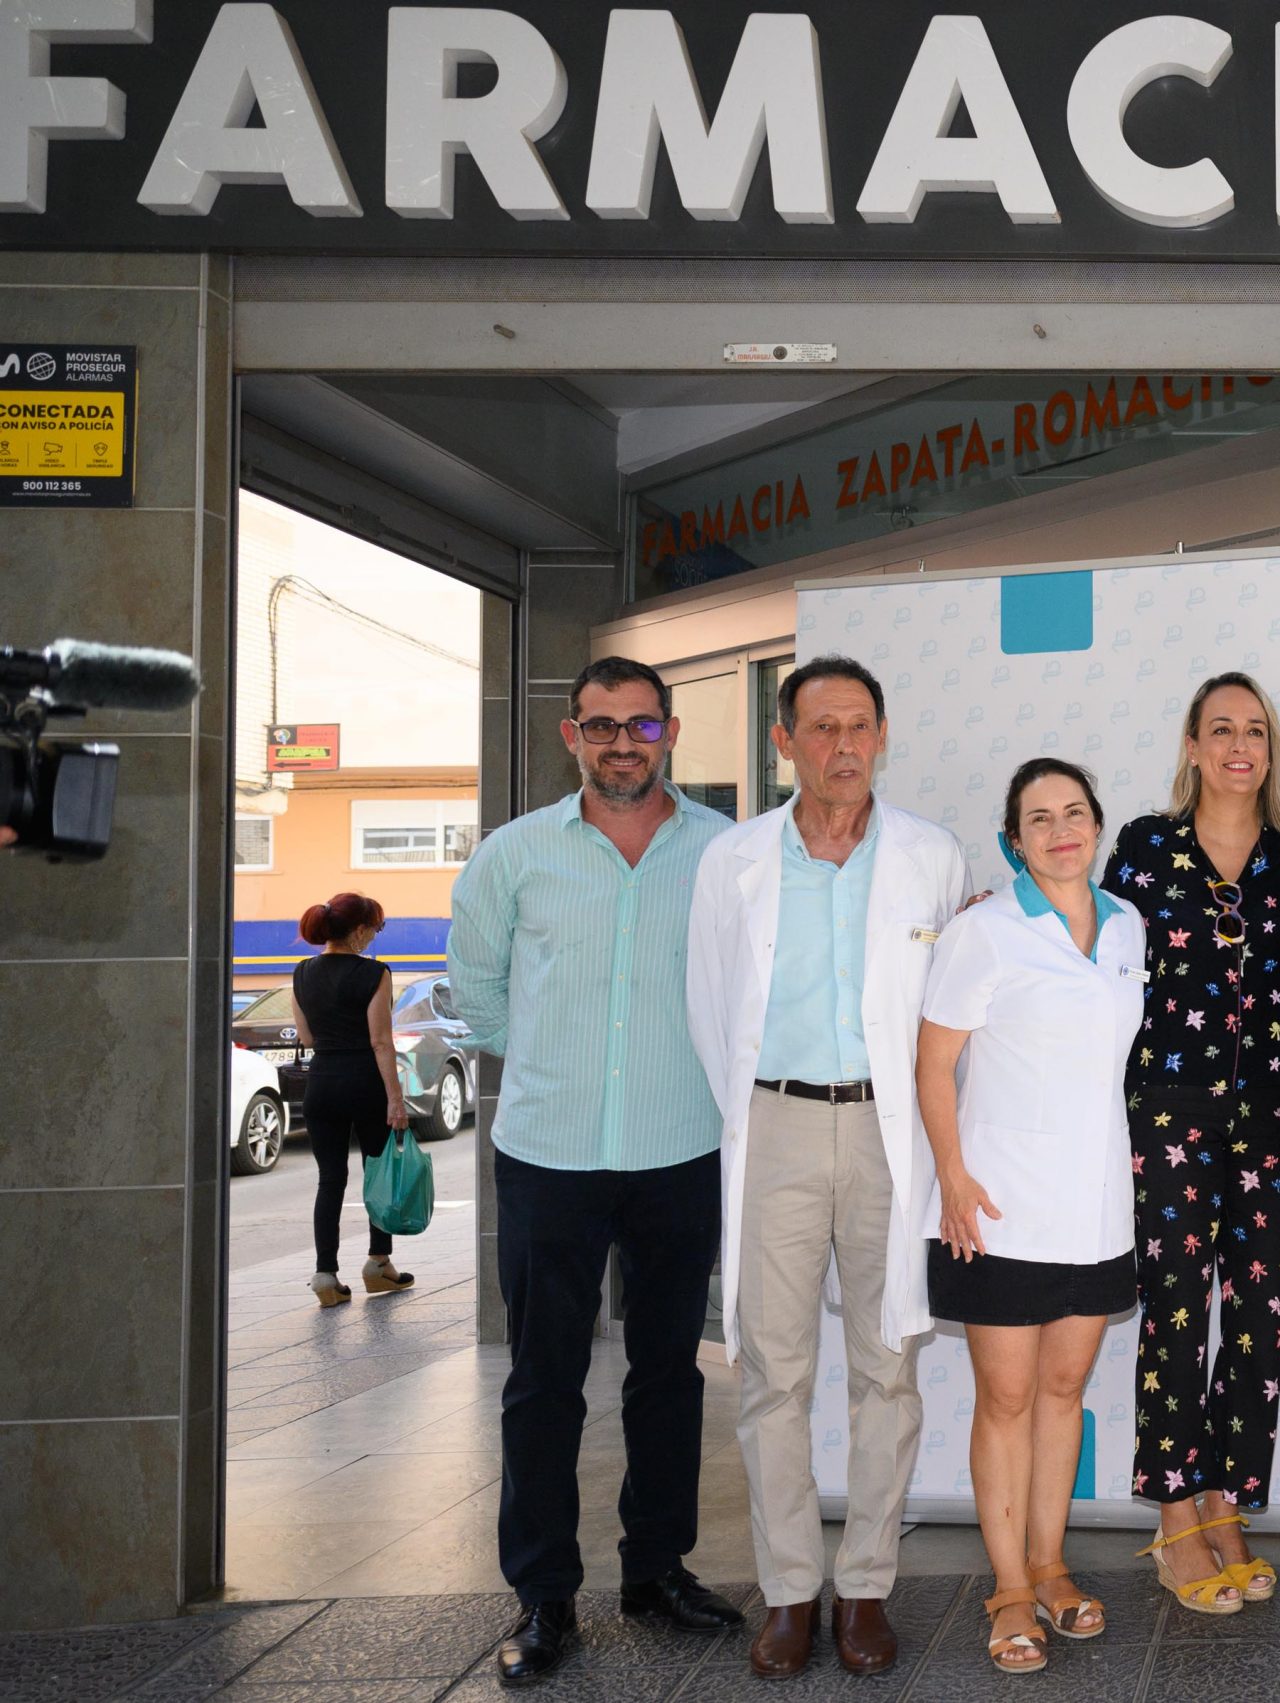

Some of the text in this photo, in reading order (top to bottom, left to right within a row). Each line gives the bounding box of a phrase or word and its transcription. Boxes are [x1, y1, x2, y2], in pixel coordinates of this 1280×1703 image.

[66, 353, 121, 362] MOVISTAR
[66, 363, 126, 373] PROSEGUR
[65, 373, 113, 382] ALARMAS
[0, 420, 114, 431] ON AVISO A POLICÍA
[23, 481, 81, 491] 900 112 365
[642, 472, 811, 568] FARMACIA
